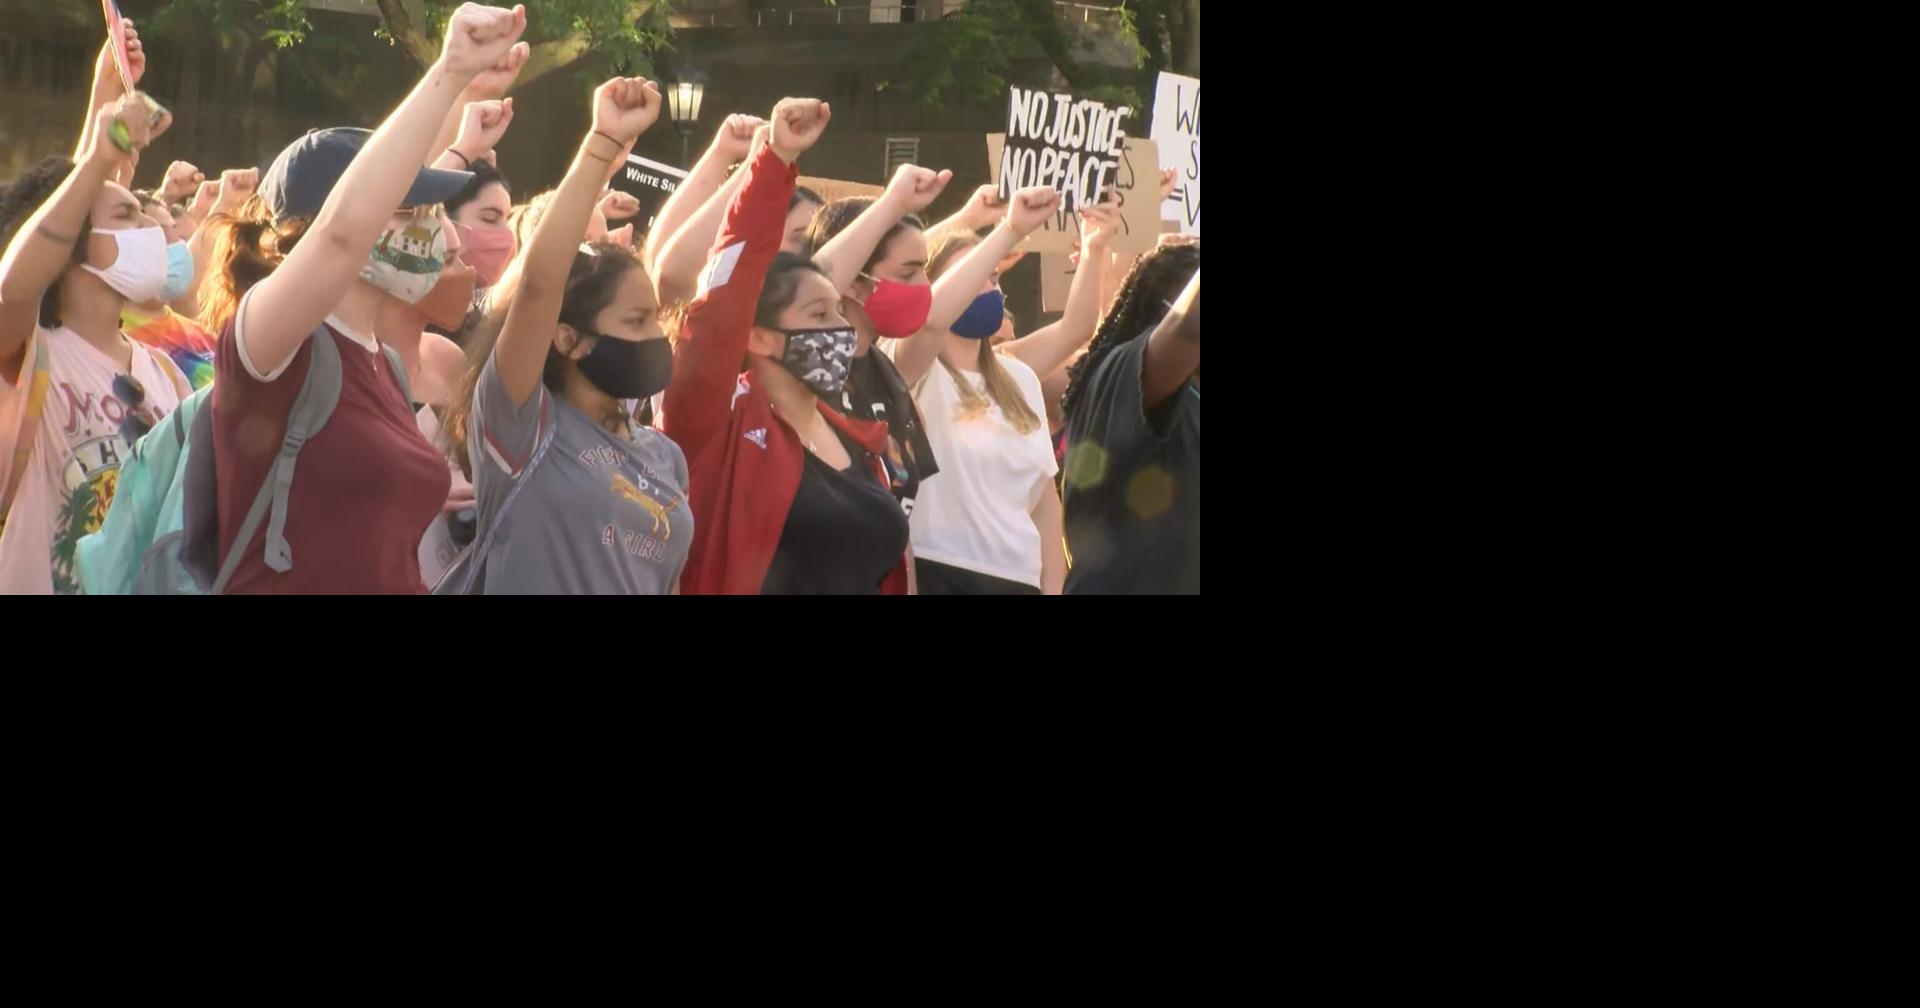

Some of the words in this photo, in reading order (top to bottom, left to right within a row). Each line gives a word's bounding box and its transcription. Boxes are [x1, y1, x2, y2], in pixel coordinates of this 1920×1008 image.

[1008, 88, 1048, 139] NO
[1045, 92, 1126, 157] JUSTICE
[626, 167, 659, 187] WHITE
[602, 523, 615, 546] A
